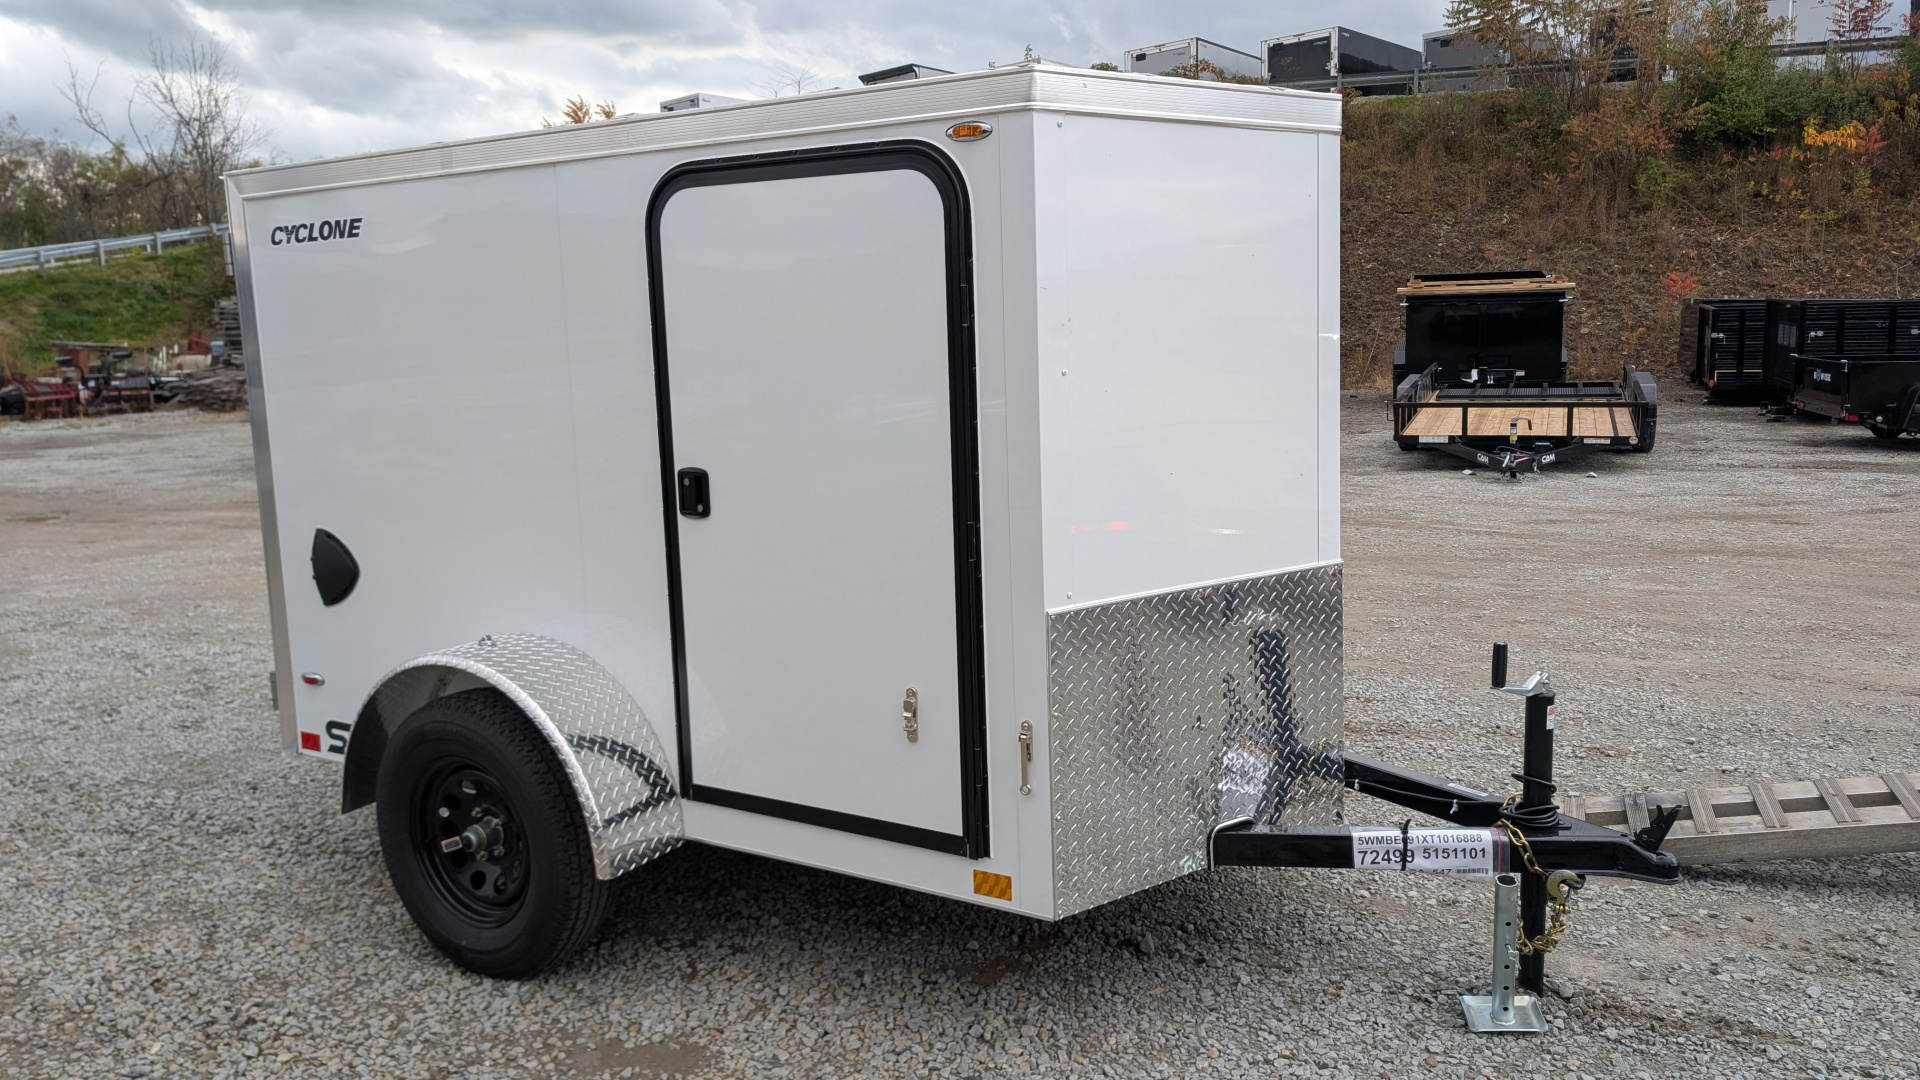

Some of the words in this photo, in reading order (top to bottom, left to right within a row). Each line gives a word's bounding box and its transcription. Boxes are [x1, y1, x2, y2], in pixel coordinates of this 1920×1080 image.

[270, 217, 363, 246] CYCLONE
[1541, 453, 1556, 463] CAM
[1358, 834, 1483, 846] 5WMBE91XT1016888
[1358, 848, 1415, 865] 72499
[1422, 847, 1486, 860] 5151101
